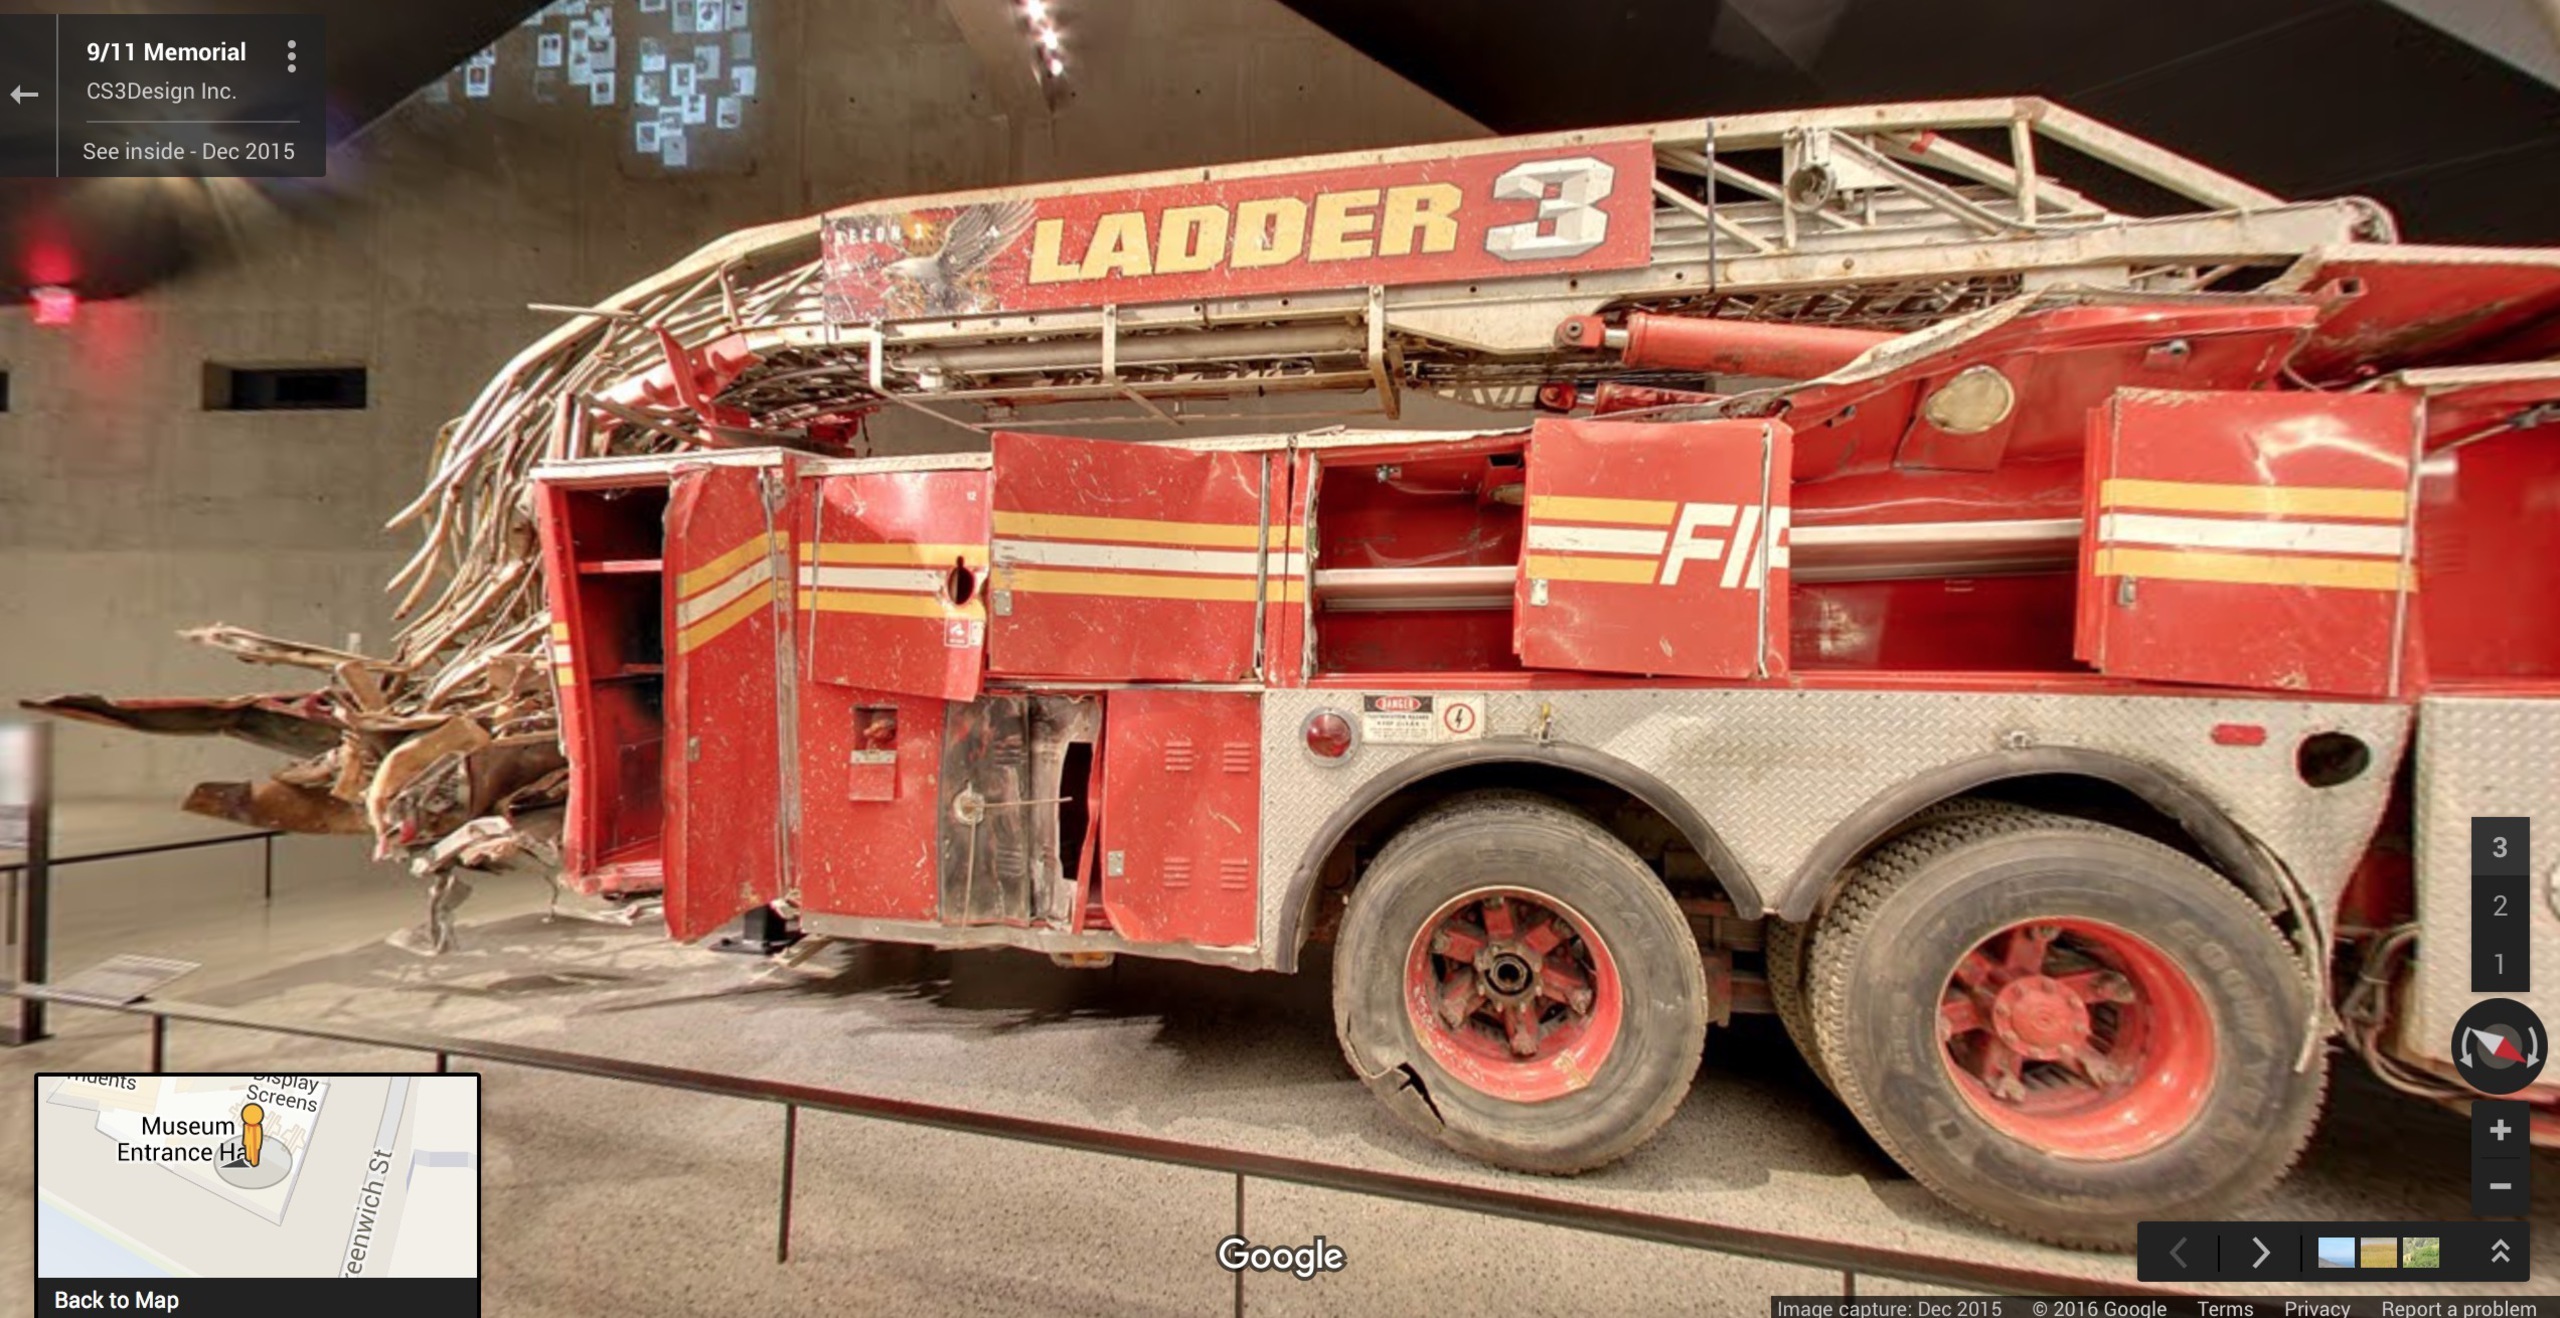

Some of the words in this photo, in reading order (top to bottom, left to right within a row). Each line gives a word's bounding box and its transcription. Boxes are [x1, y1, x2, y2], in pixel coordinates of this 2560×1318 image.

[834, 225, 901, 248] RECON
[1028, 182, 1464, 284] LADDER
[1485, 156, 1617, 262] 3
